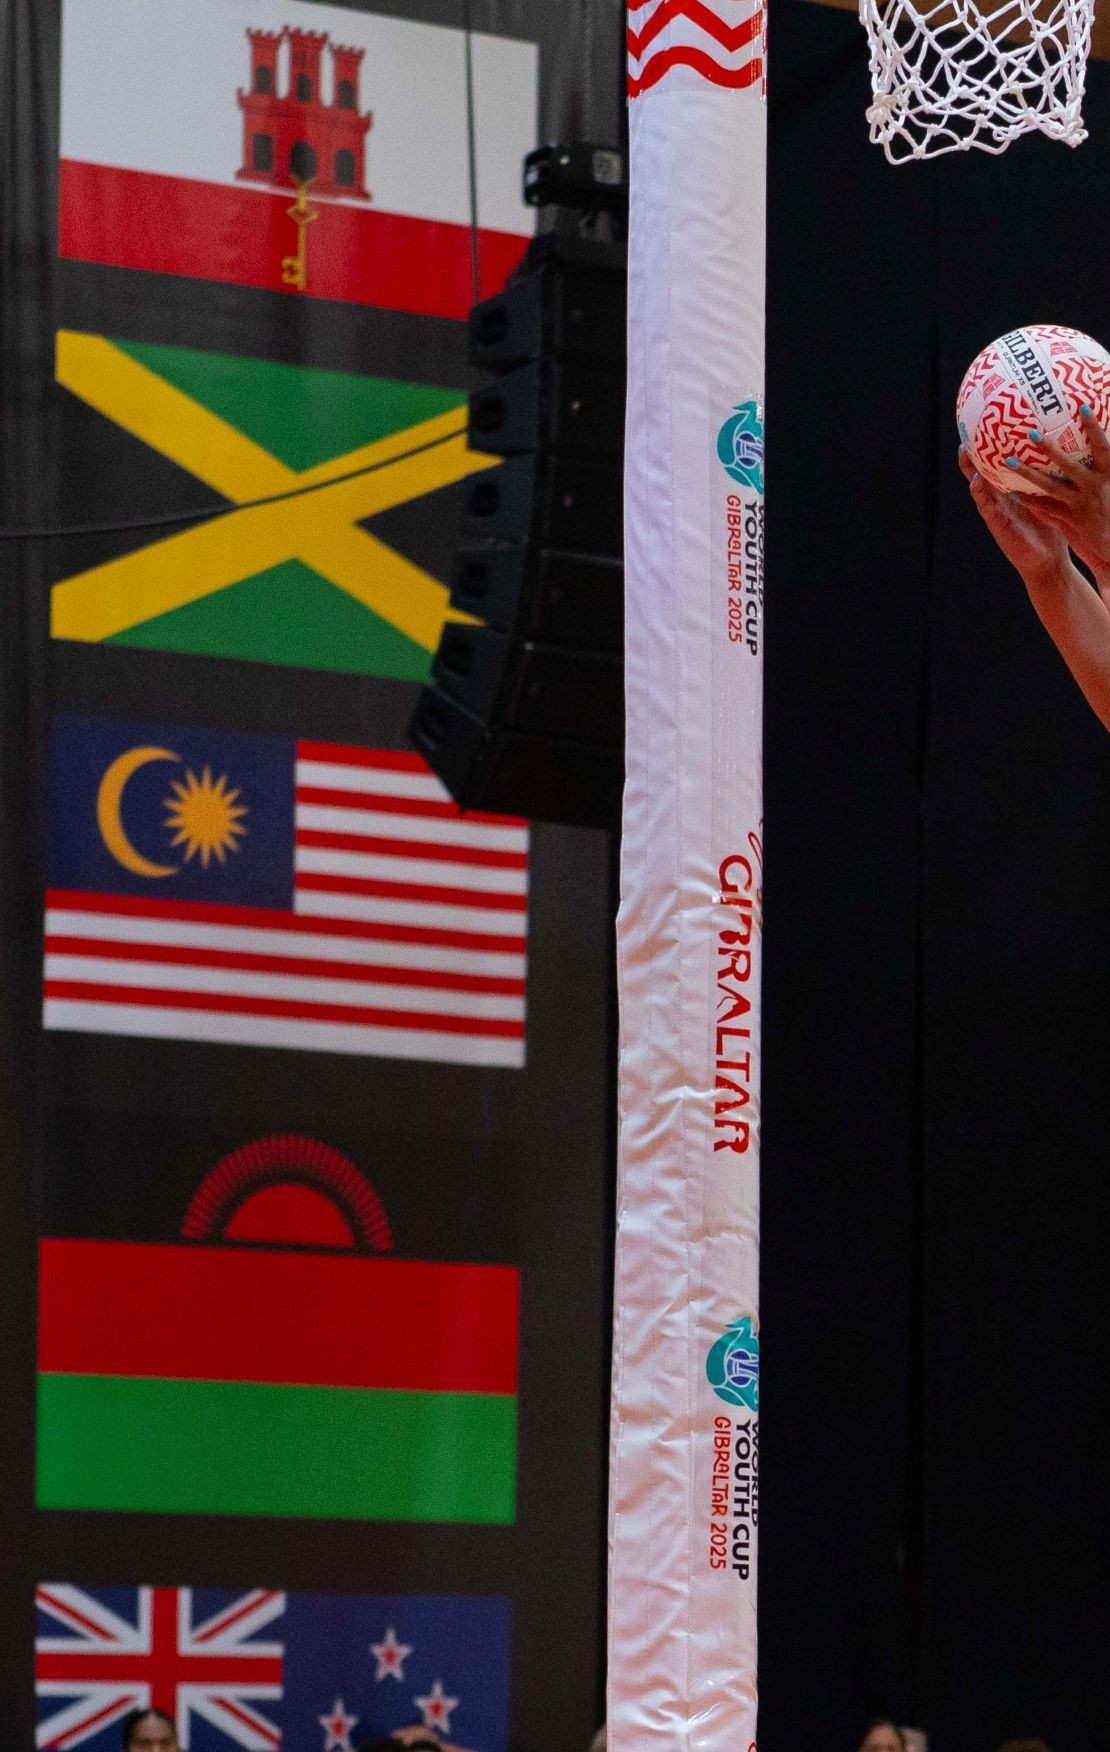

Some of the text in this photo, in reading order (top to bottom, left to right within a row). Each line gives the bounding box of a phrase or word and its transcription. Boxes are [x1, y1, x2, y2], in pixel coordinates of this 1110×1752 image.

[726, 494, 743, 643] GIBRALTAR 2025
[744, 500, 758, 656] YOUTH CUP
[709, 1415, 731, 1570] GIBRALTAR 2025
[731, 1418, 751, 1581] YOUTH CUP
